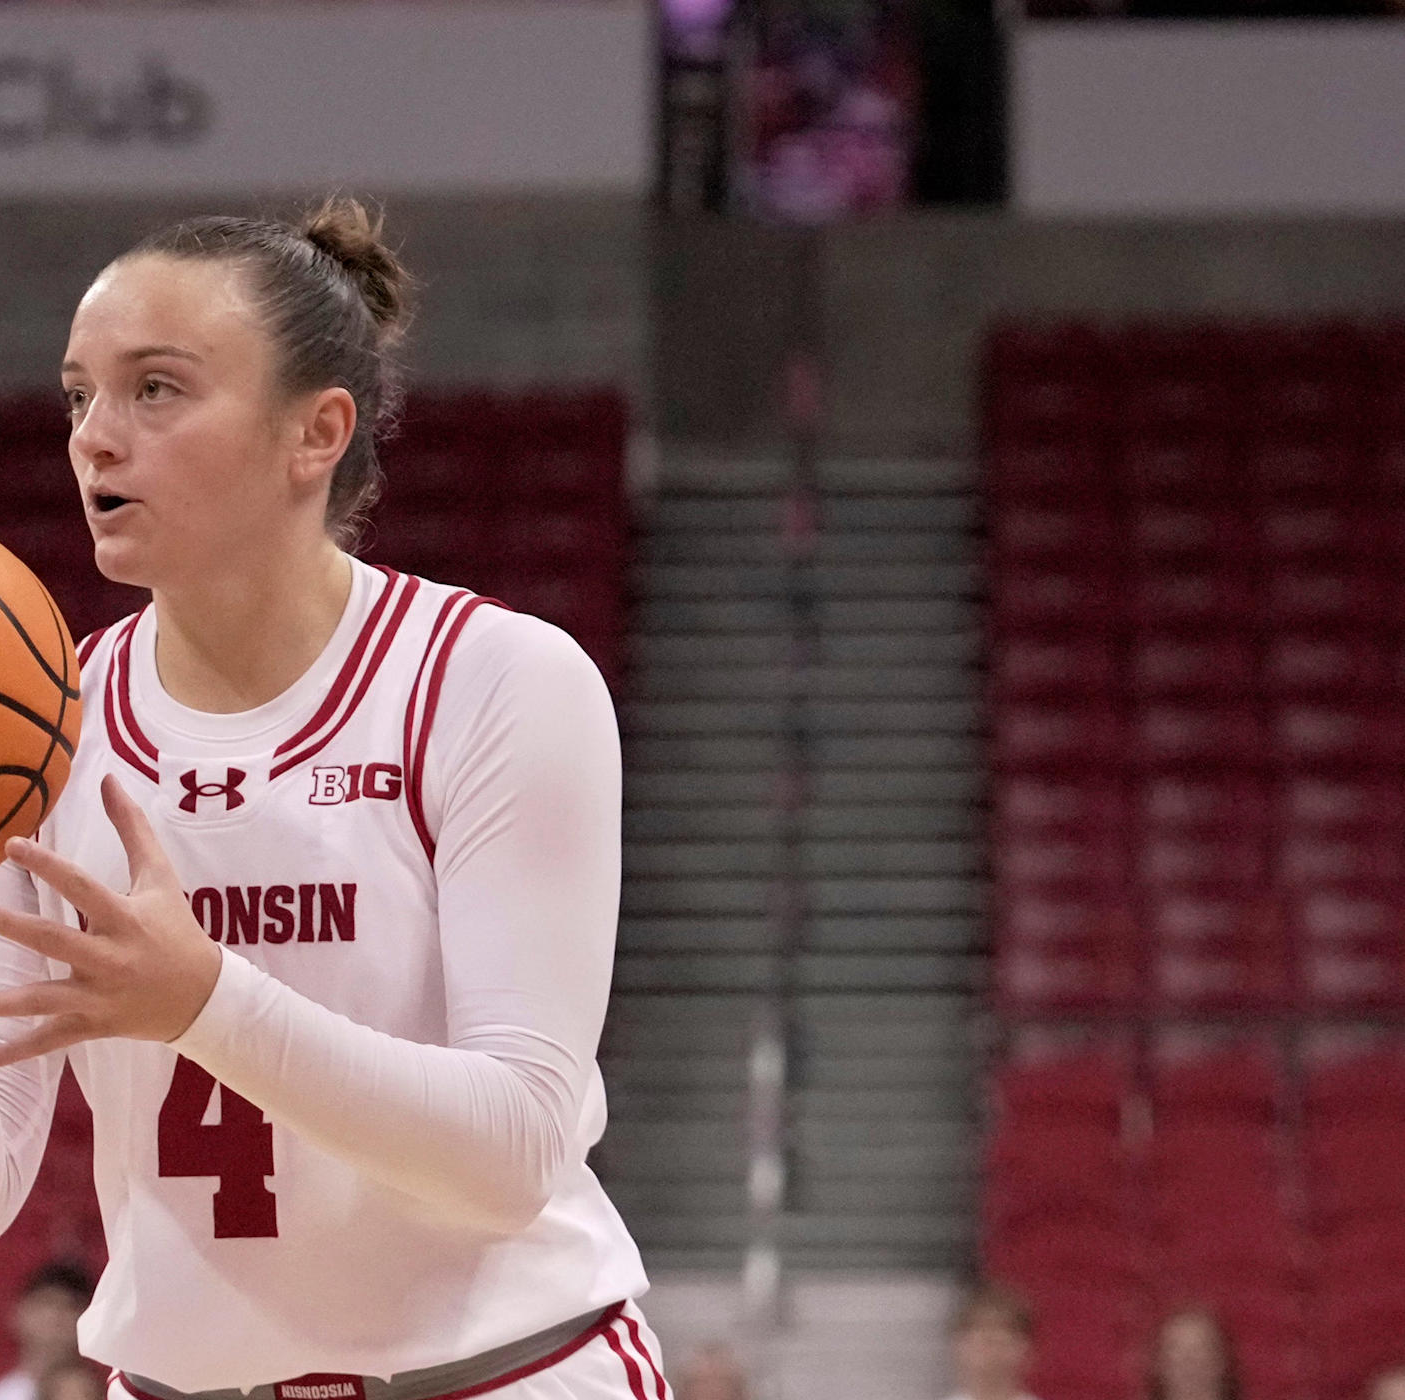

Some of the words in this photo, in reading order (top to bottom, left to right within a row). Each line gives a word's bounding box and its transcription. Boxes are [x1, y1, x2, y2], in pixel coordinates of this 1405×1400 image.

[181, 883, 357, 945] ONSIN
[158, 1054, 278, 1238] 4
[281, 1382, 357, 1399] WISCONSIN
